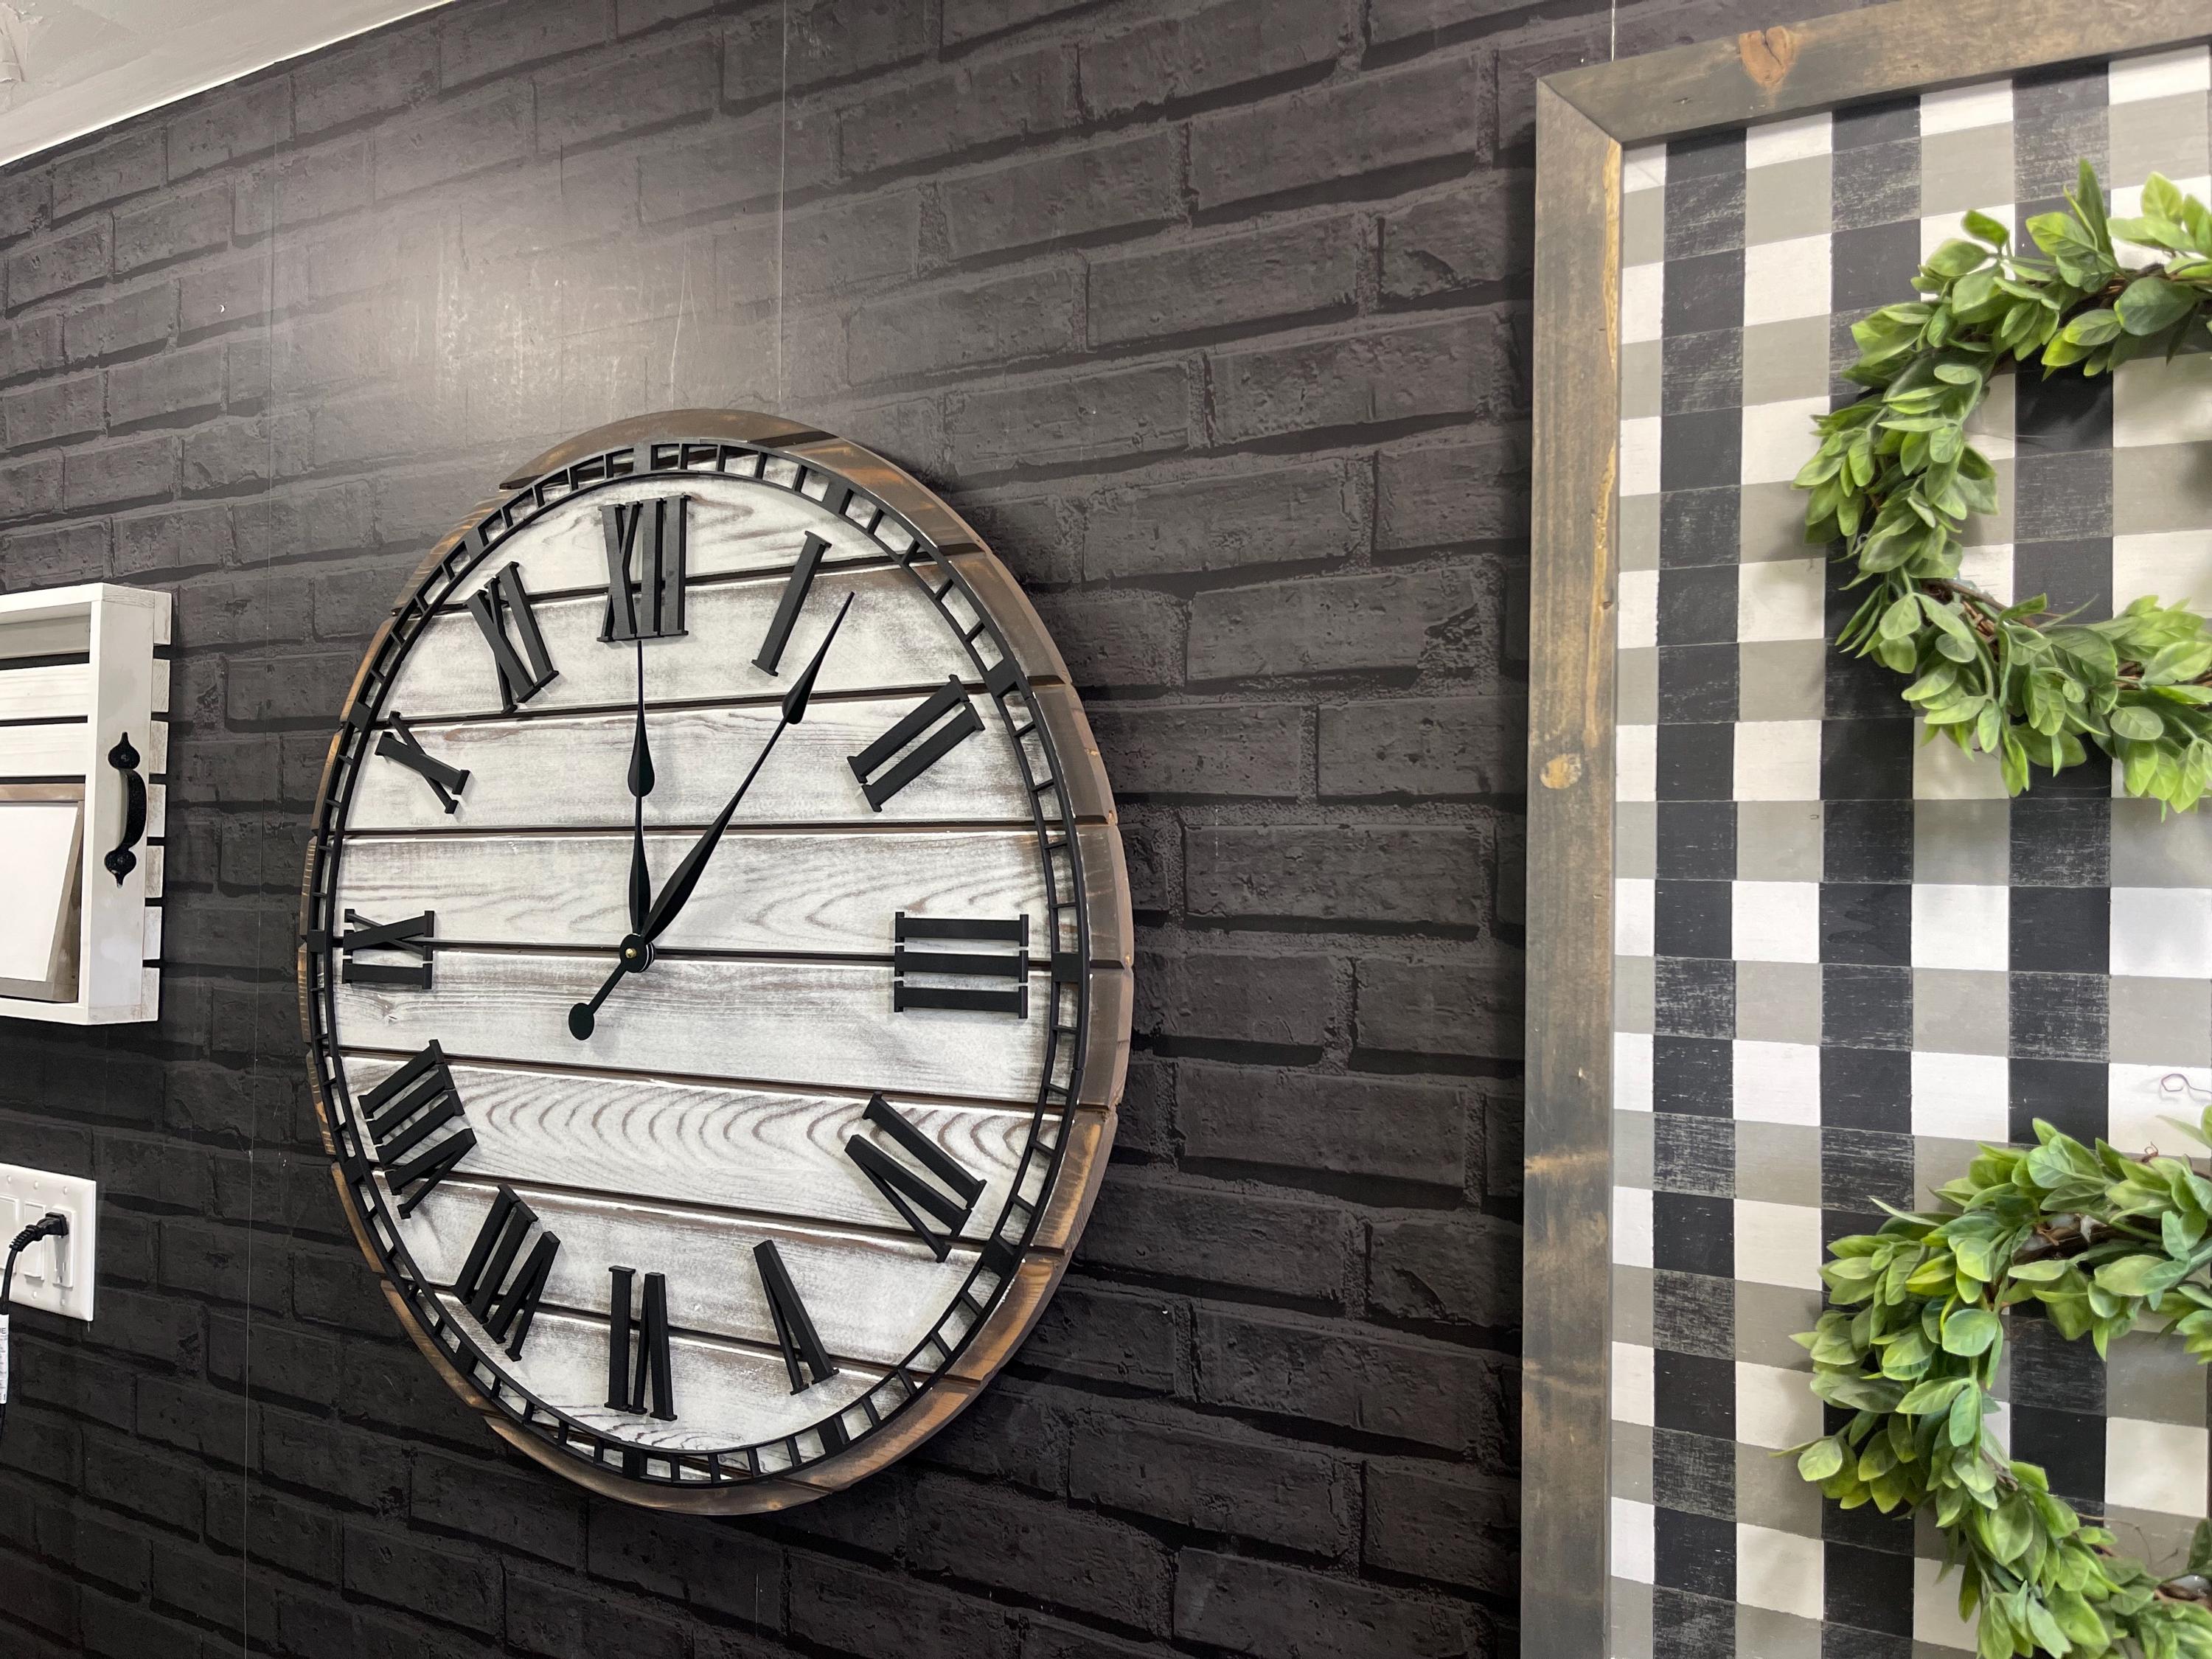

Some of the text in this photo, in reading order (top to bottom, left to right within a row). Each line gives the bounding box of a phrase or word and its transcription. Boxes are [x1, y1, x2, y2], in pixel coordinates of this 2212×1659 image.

[467, 561, 559, 714] XI
[597, 495, 691, 642] XII
[751, 531, 832, 677] I
[375, 711, 470, 814] X
[846, 675, 985, 813] II
[342, 908, 434, 990] IX
[894, 911, 1029, 1018] III
[358, 1039, 477, 1219] VIII
[844, 1092, 987, 1263] IV
[454, 1184, 560, 1361] VII
[604, 1265, 678, 1422] VI
[753, 1239, 838, 1395] V
